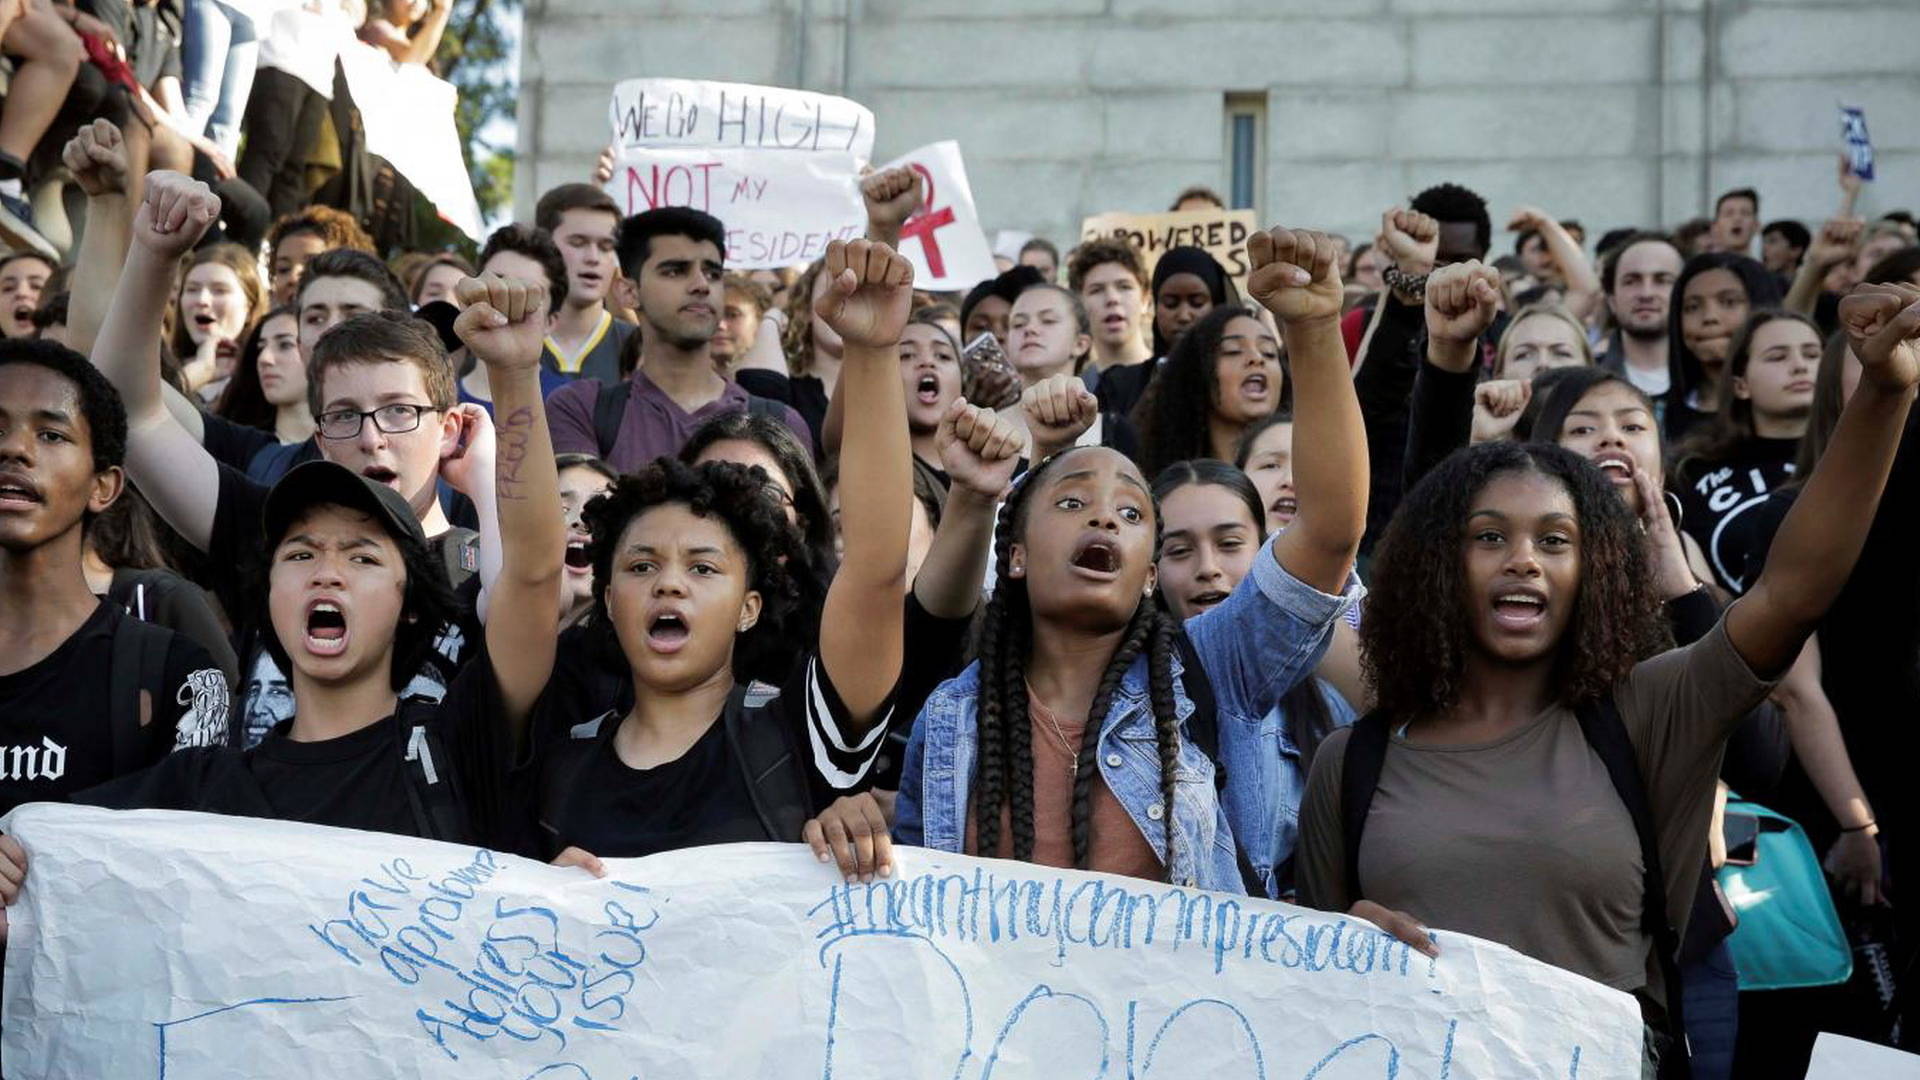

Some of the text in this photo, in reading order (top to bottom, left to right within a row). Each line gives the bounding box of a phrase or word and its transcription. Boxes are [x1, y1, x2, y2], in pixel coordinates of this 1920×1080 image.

[614, 90, 659, 140] WE
[627, 163, 768, 218] NOT MY
[724, 225, 857, 263] ESIDENT
[1087, 221, 1247, 251] POWERED
